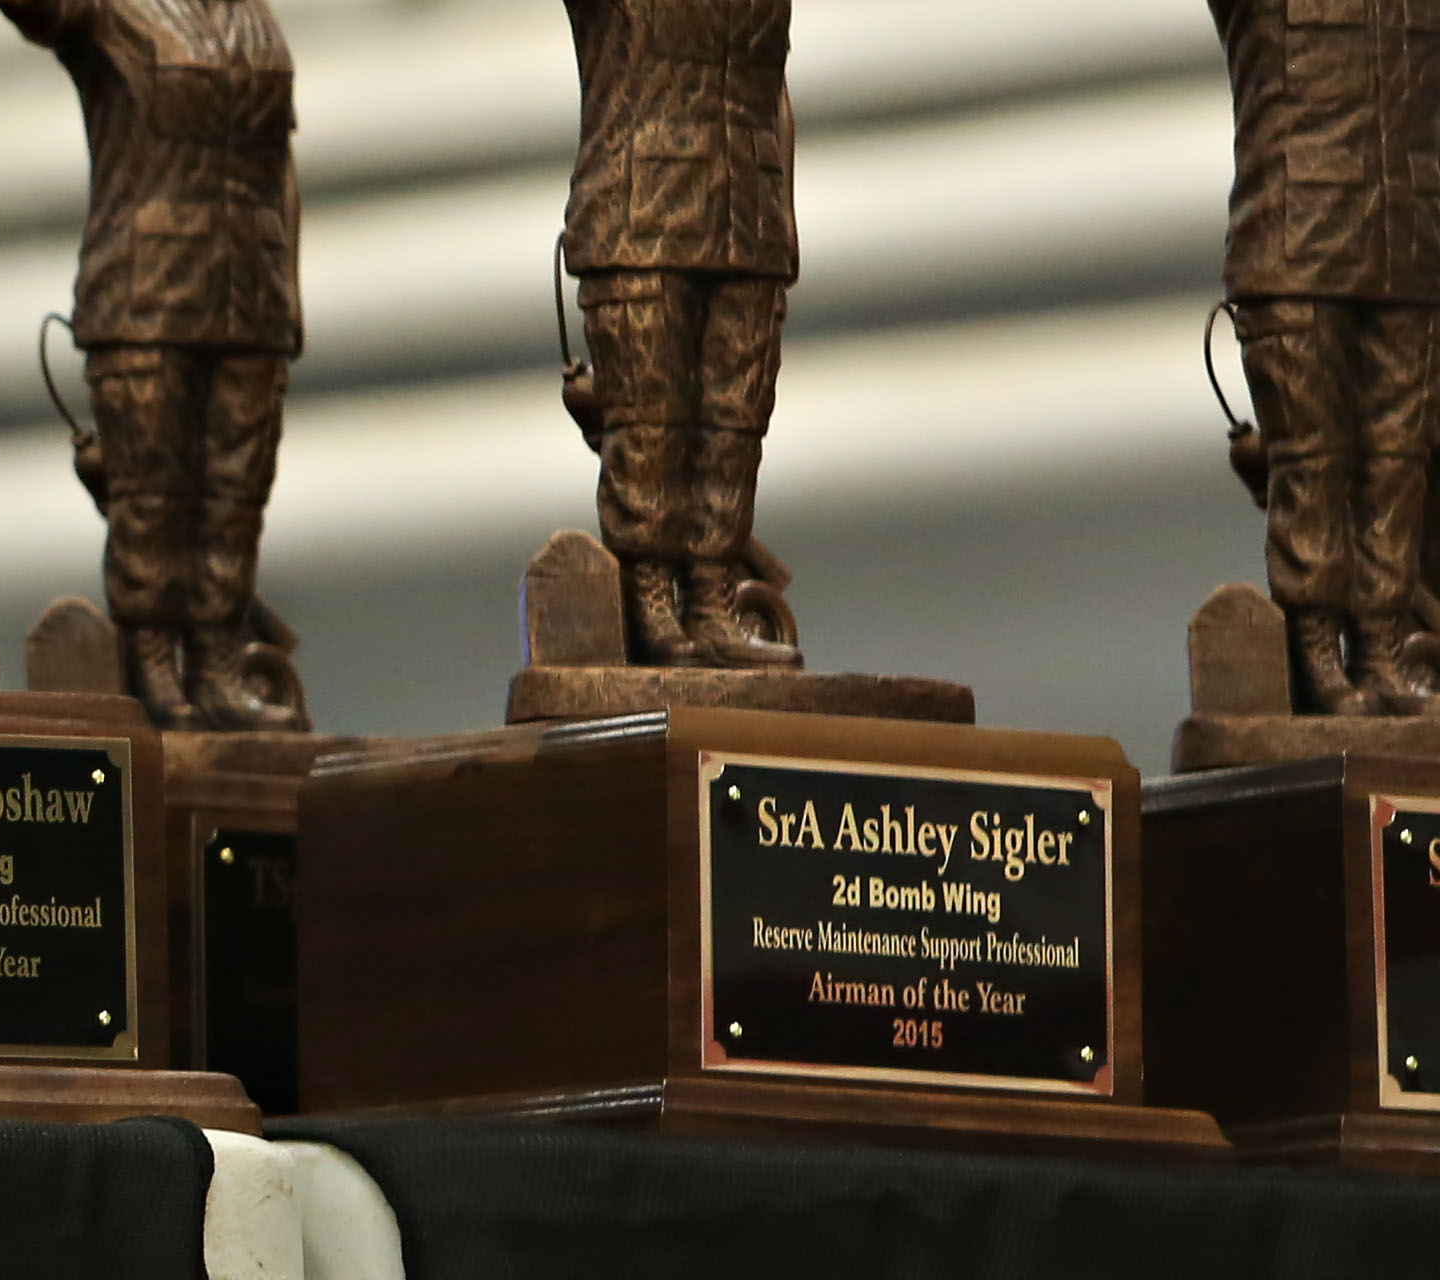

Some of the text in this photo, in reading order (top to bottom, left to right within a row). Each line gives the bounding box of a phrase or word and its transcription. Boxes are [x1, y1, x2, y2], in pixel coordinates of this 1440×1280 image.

[758, 797, 1072, 881] SrA Ashley Sigler
[833, 875, 1000, 923] 2d Bomb Wing
[753, 917, 1078, 970] Reserve Maintenance Support Professional
[809, 972, 1025, 1014] Airman of the Year
[893, 1019, 942, 1048] 2015
